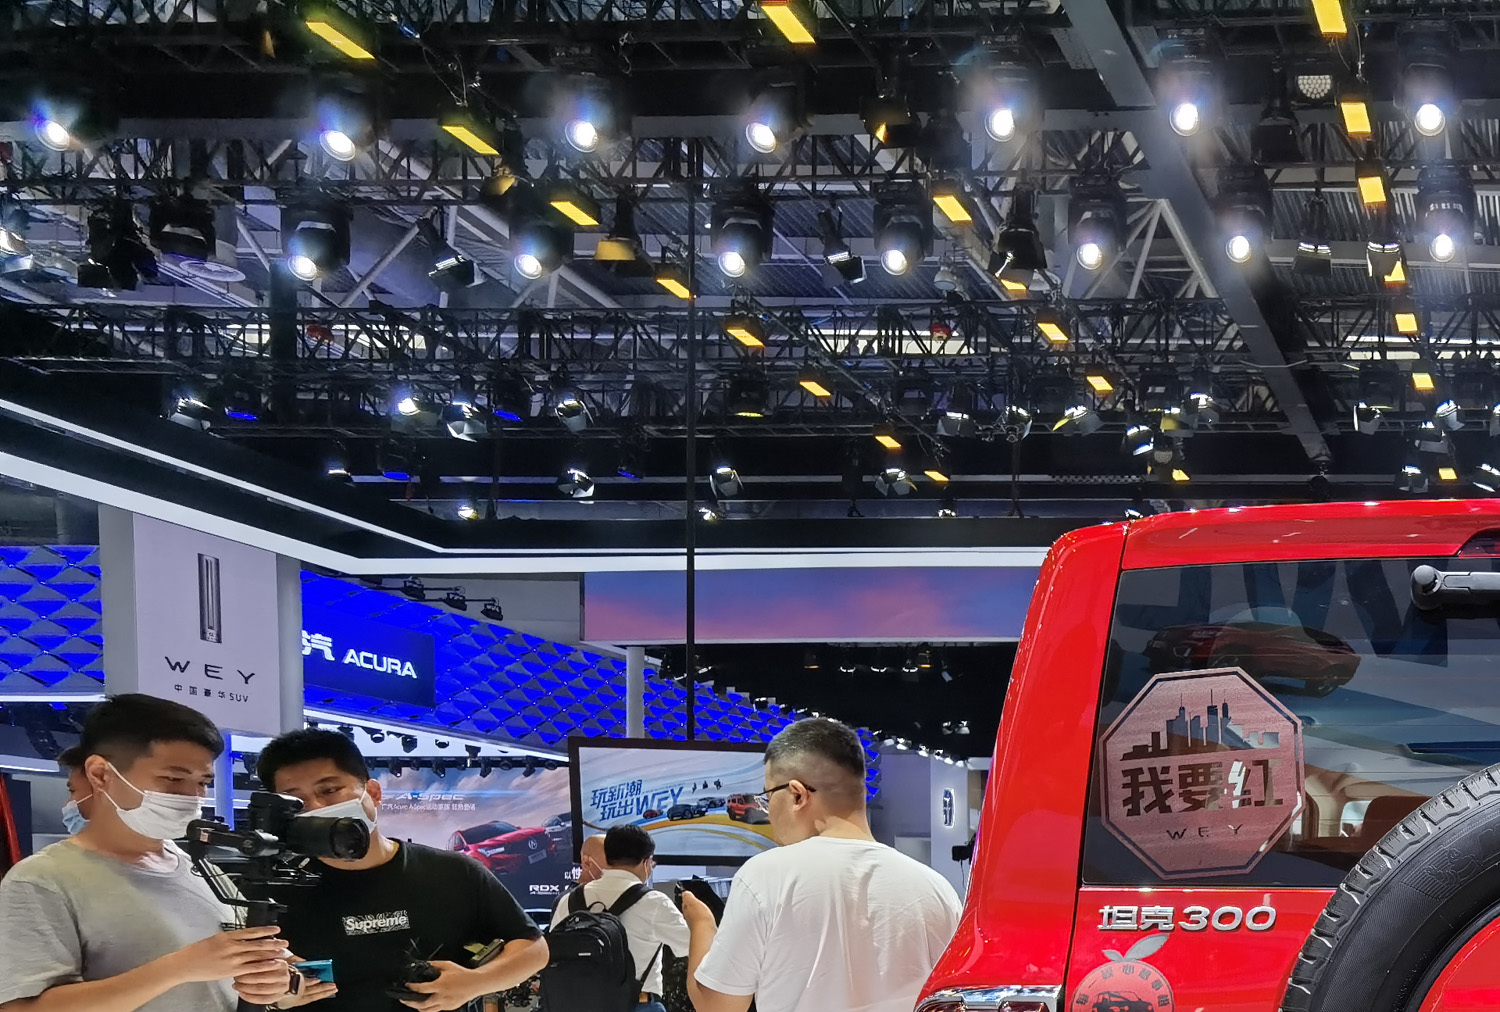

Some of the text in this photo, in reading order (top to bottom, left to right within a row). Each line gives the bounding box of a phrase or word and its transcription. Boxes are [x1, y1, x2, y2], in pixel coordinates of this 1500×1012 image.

[165, 656, 256, 684] WEY
[343, 648, 418, 679] ACURA
[590, 779, 643, 809] 玩新潮
[1121, 759, 1284, 817] 我要红
[1167, 824, 1244, 840] WEY
[346, 915, 407, 934] Supreme
[1097, 905, 1277, 931] 坦克300
